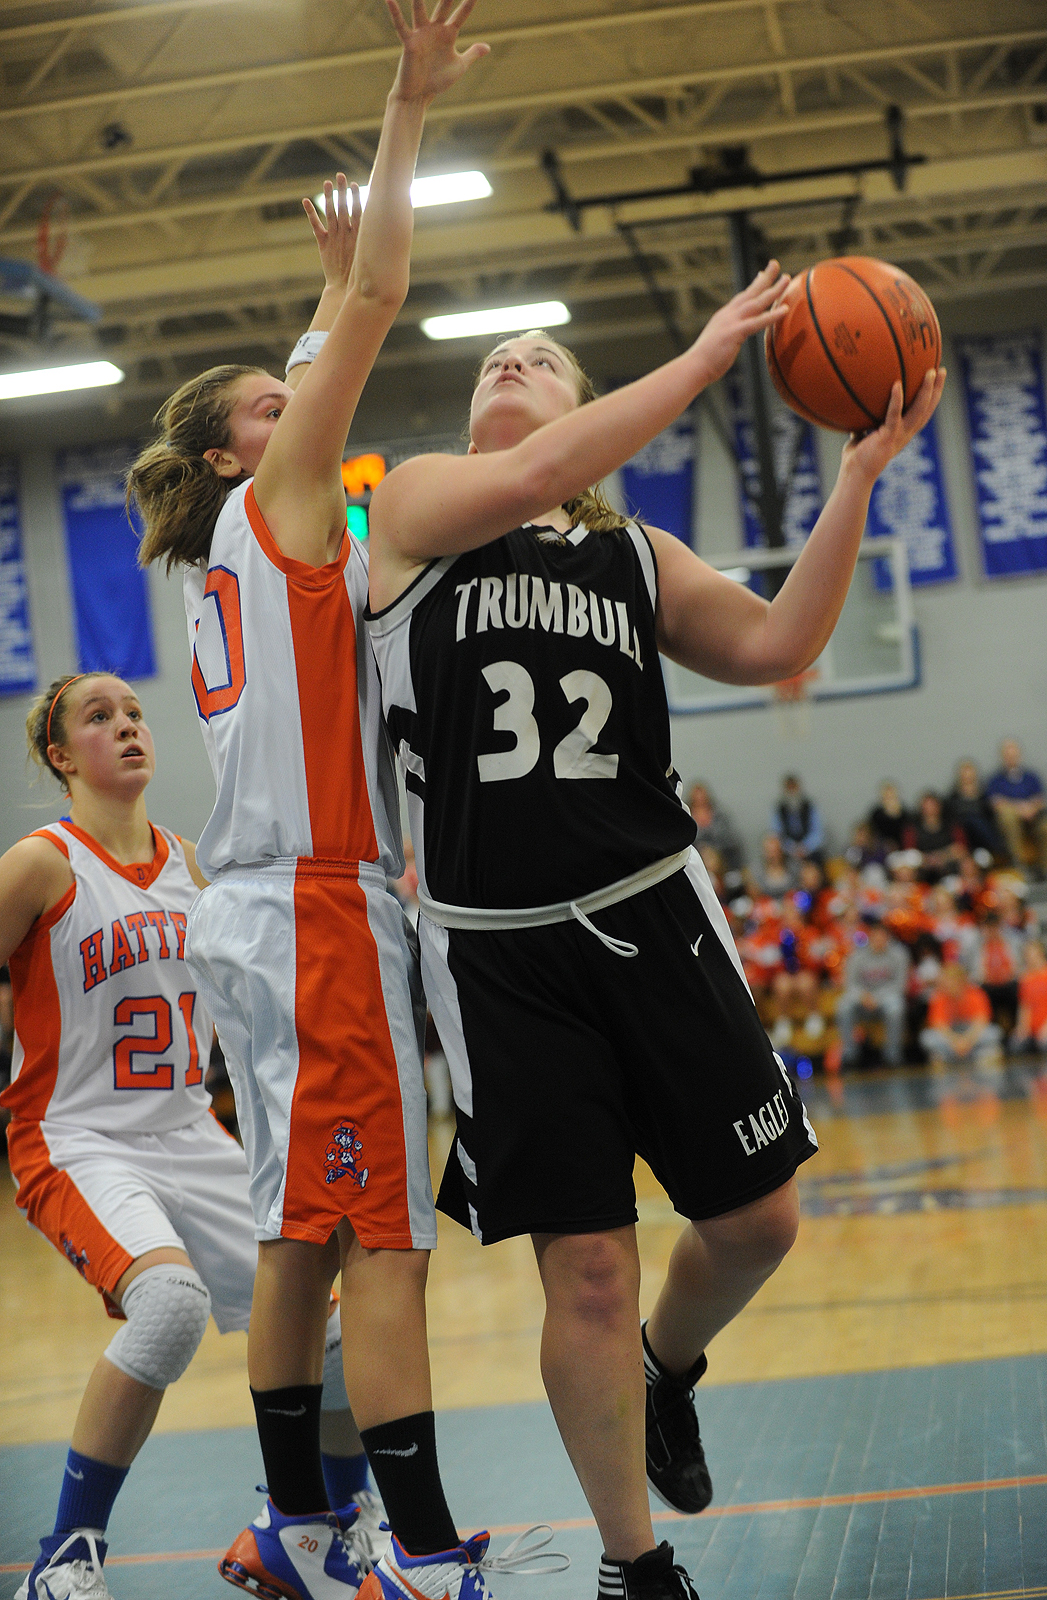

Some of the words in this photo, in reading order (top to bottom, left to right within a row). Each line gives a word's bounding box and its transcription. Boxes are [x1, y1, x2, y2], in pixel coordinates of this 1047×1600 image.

[477, 661, 619, 783] 32
[113, 991, 203, 1090] 21
[297, 1534, 319, 1553] 20
